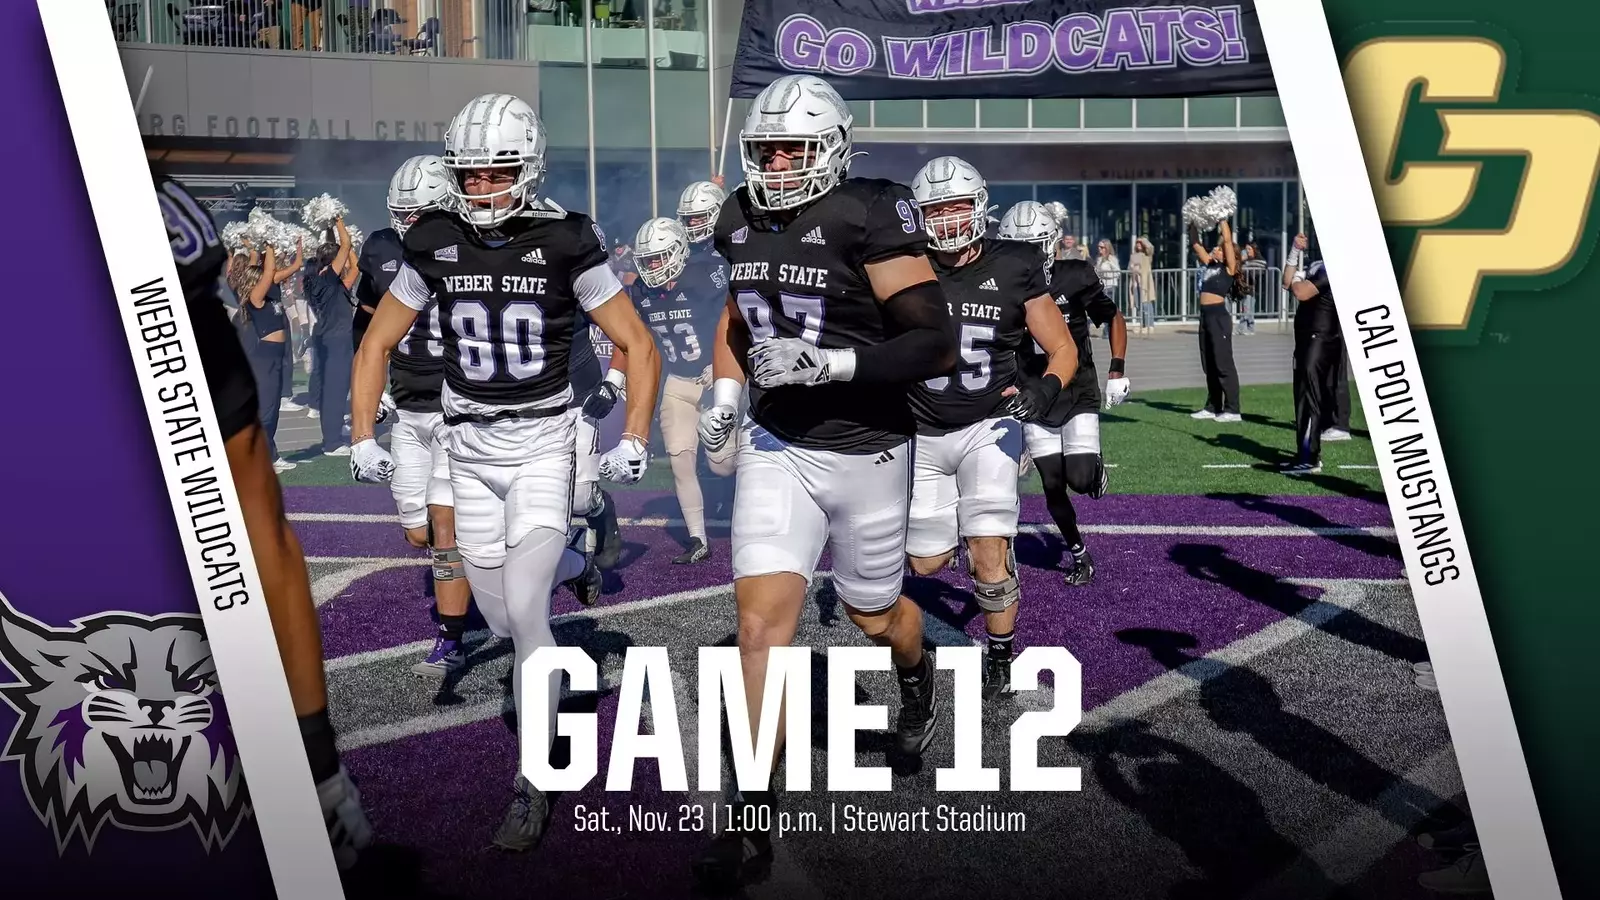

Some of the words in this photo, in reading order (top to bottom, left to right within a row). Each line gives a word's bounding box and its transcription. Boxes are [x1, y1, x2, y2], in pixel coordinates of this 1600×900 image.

[776, 14, 873, 74] GO
[883, 5, 1248, 80] WILDCATS!
[207, 115, 355, 140] FOOTBALL
[896, 199, 926, 234] 97
[442, 275, 493, 293] WEBER
[501, 275, 547, 294] STATE
[778, 263, 828, 288] STATE
[669, 309, 692, 319] STATE
[961, 302, 1001, 321] STATE
[450, 300, 546, 382] 80
